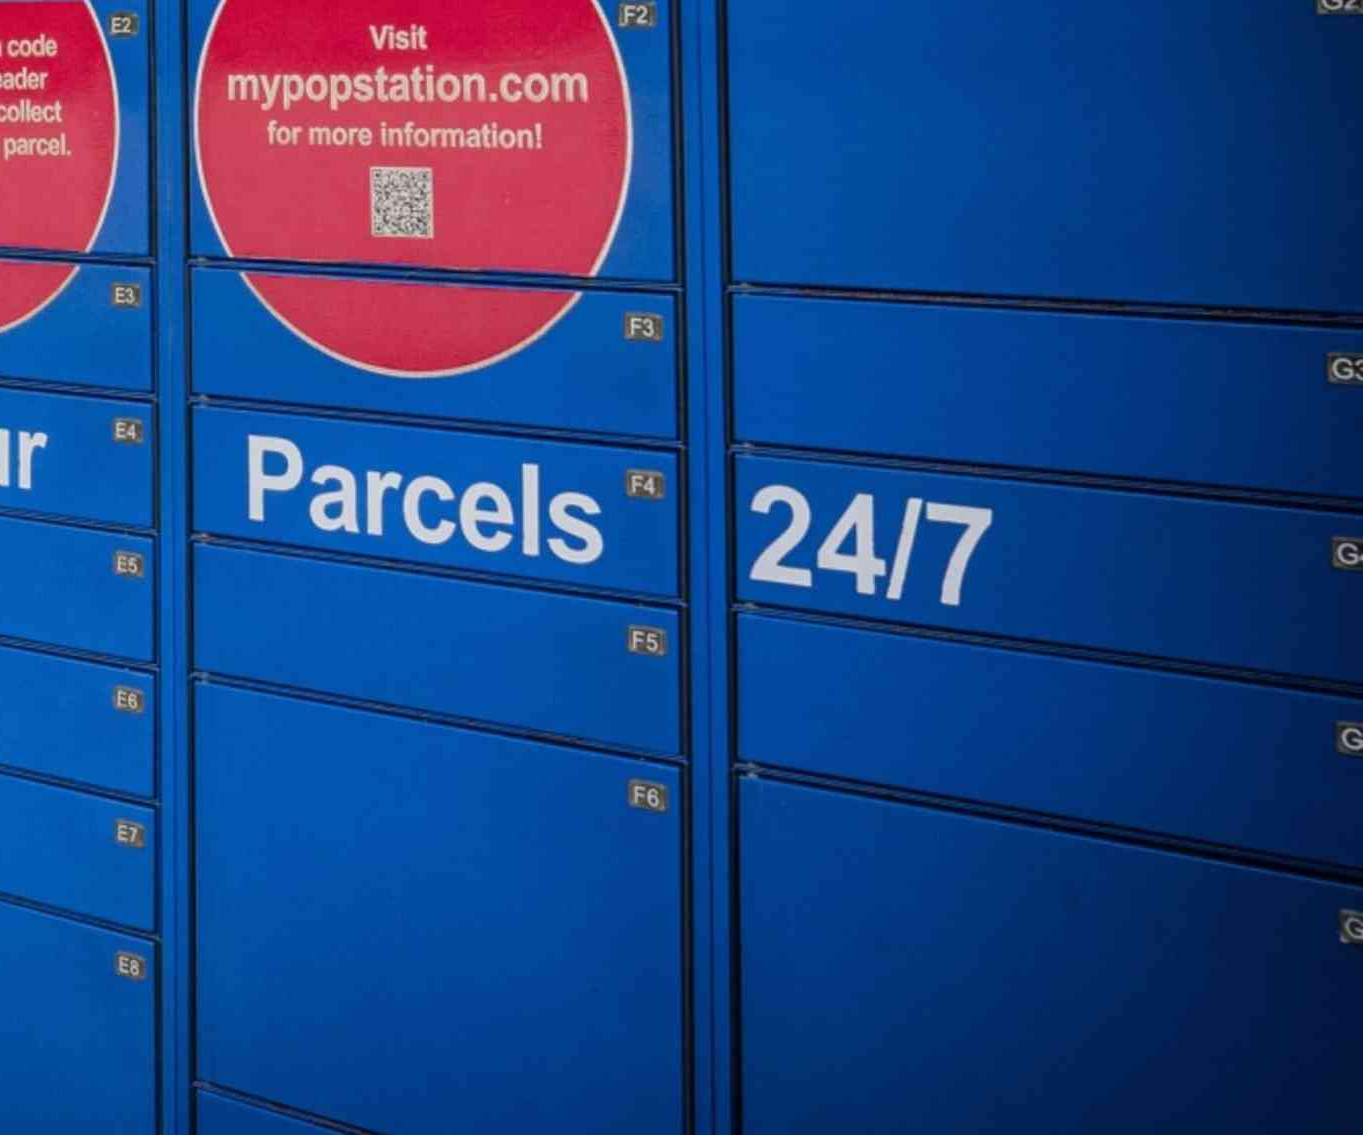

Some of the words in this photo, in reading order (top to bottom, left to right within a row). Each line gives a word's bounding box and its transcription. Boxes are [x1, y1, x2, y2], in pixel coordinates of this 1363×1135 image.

[624, 6, 648, 24] F2
[111, 18, 131, 34] E2
[8, 34, 58, 57] code
[370, 24, 428, 51] Visit
[227, 65, 589, 111] mypopstation.com
[267, 120, 299, 146] for
[308, 127, 373, 147] more
[380, 122, 543, 149] information!
[4, 133, 72, 161] parcel.
[115, 287, 135, 304] E3
[630, 318, 654, 337] F3
[115, 423, 136, 440] E4
[631, 475, 655, 495] F4
[247, 434, 604, 566] Parcels
[748, 483, 994, 607] 24/7
[117, 556, 138, 574] E5
[632, 631, 658, 651] F5
[117, 692, 138, 710] E6
[634, 786, 659, 807] F6
[117, 825, 138, 843] E7
[119, 958, 140, 976] E8
